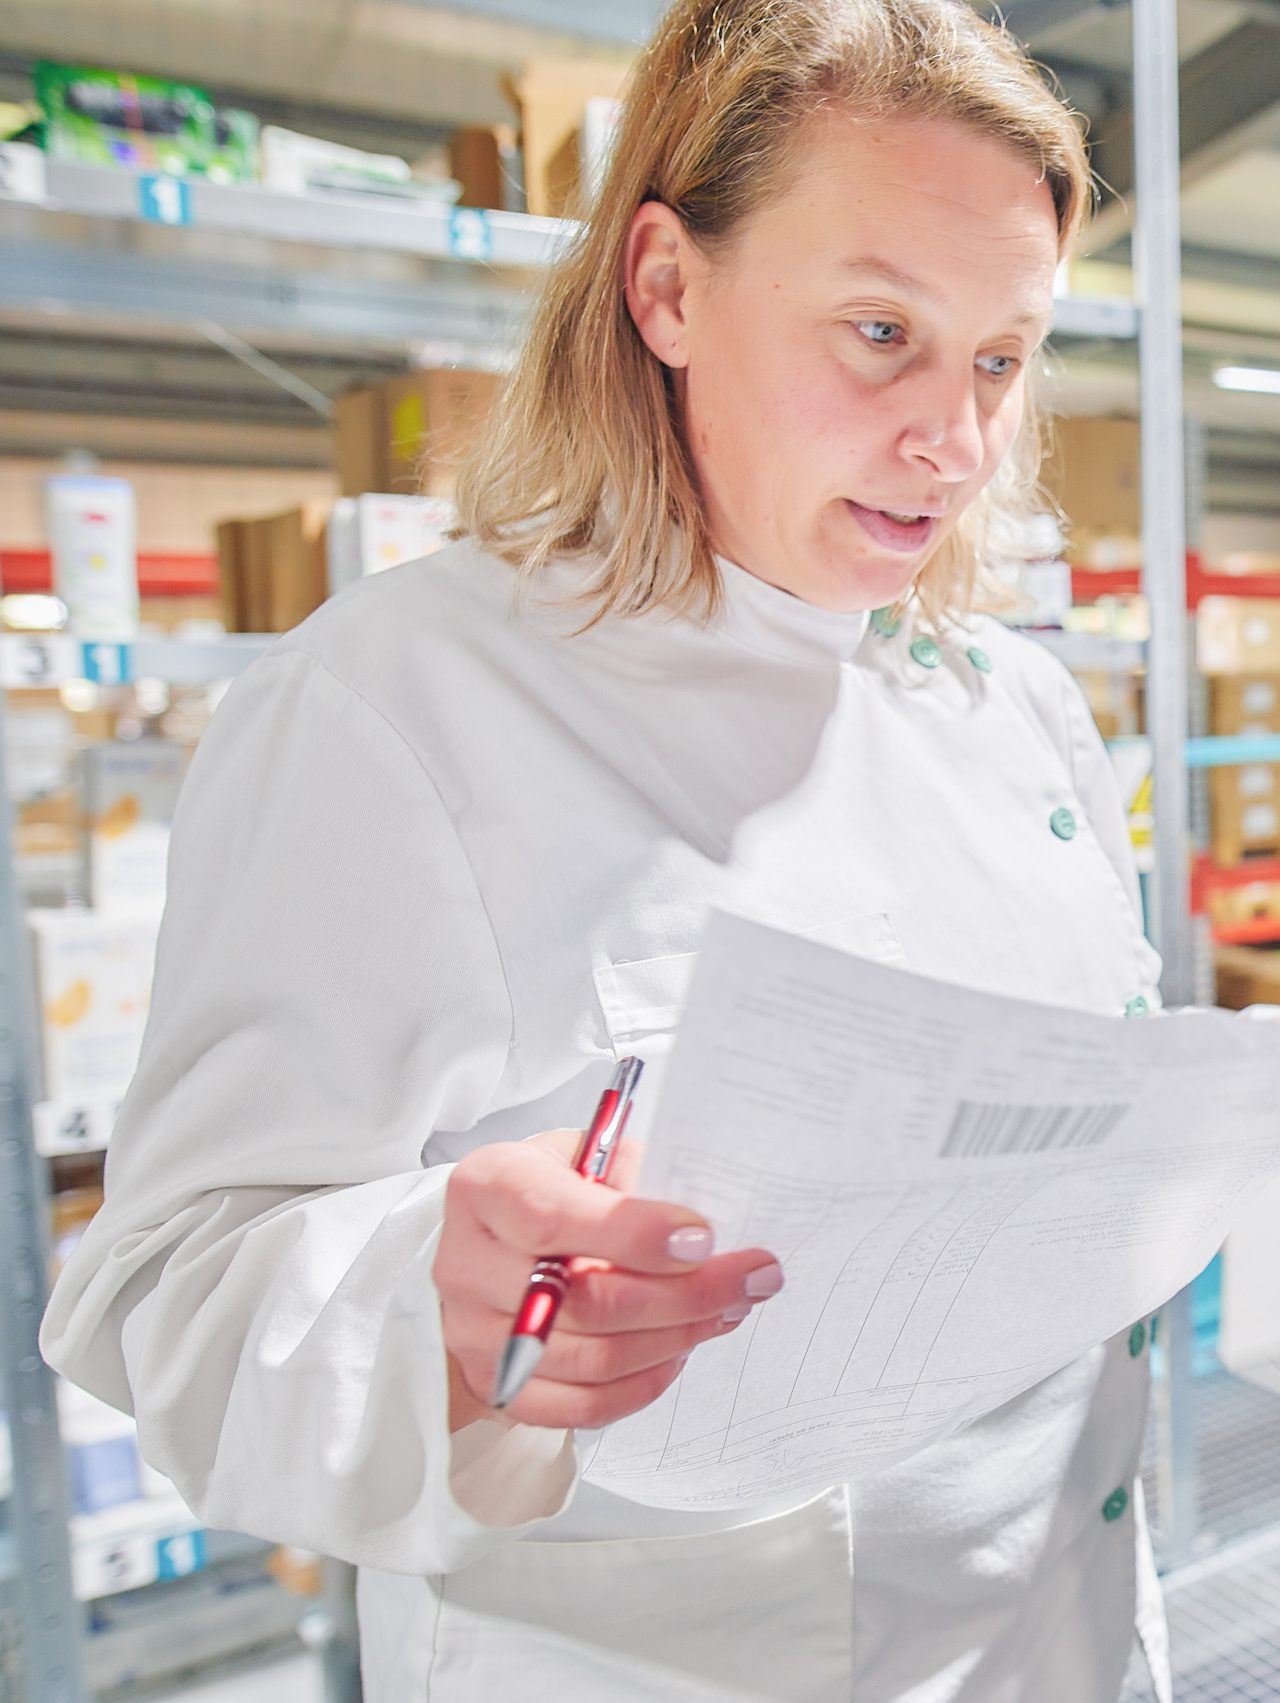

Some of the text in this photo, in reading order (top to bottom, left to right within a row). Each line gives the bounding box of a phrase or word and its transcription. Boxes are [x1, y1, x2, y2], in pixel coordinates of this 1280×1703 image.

[149, 177, 181, 223] 1
[456, 208, 483, 257] 2
[23, 639, 49, 681] 3
[89, 644, 119, 683] 1
[165, 1538, 195, 1577] 1
